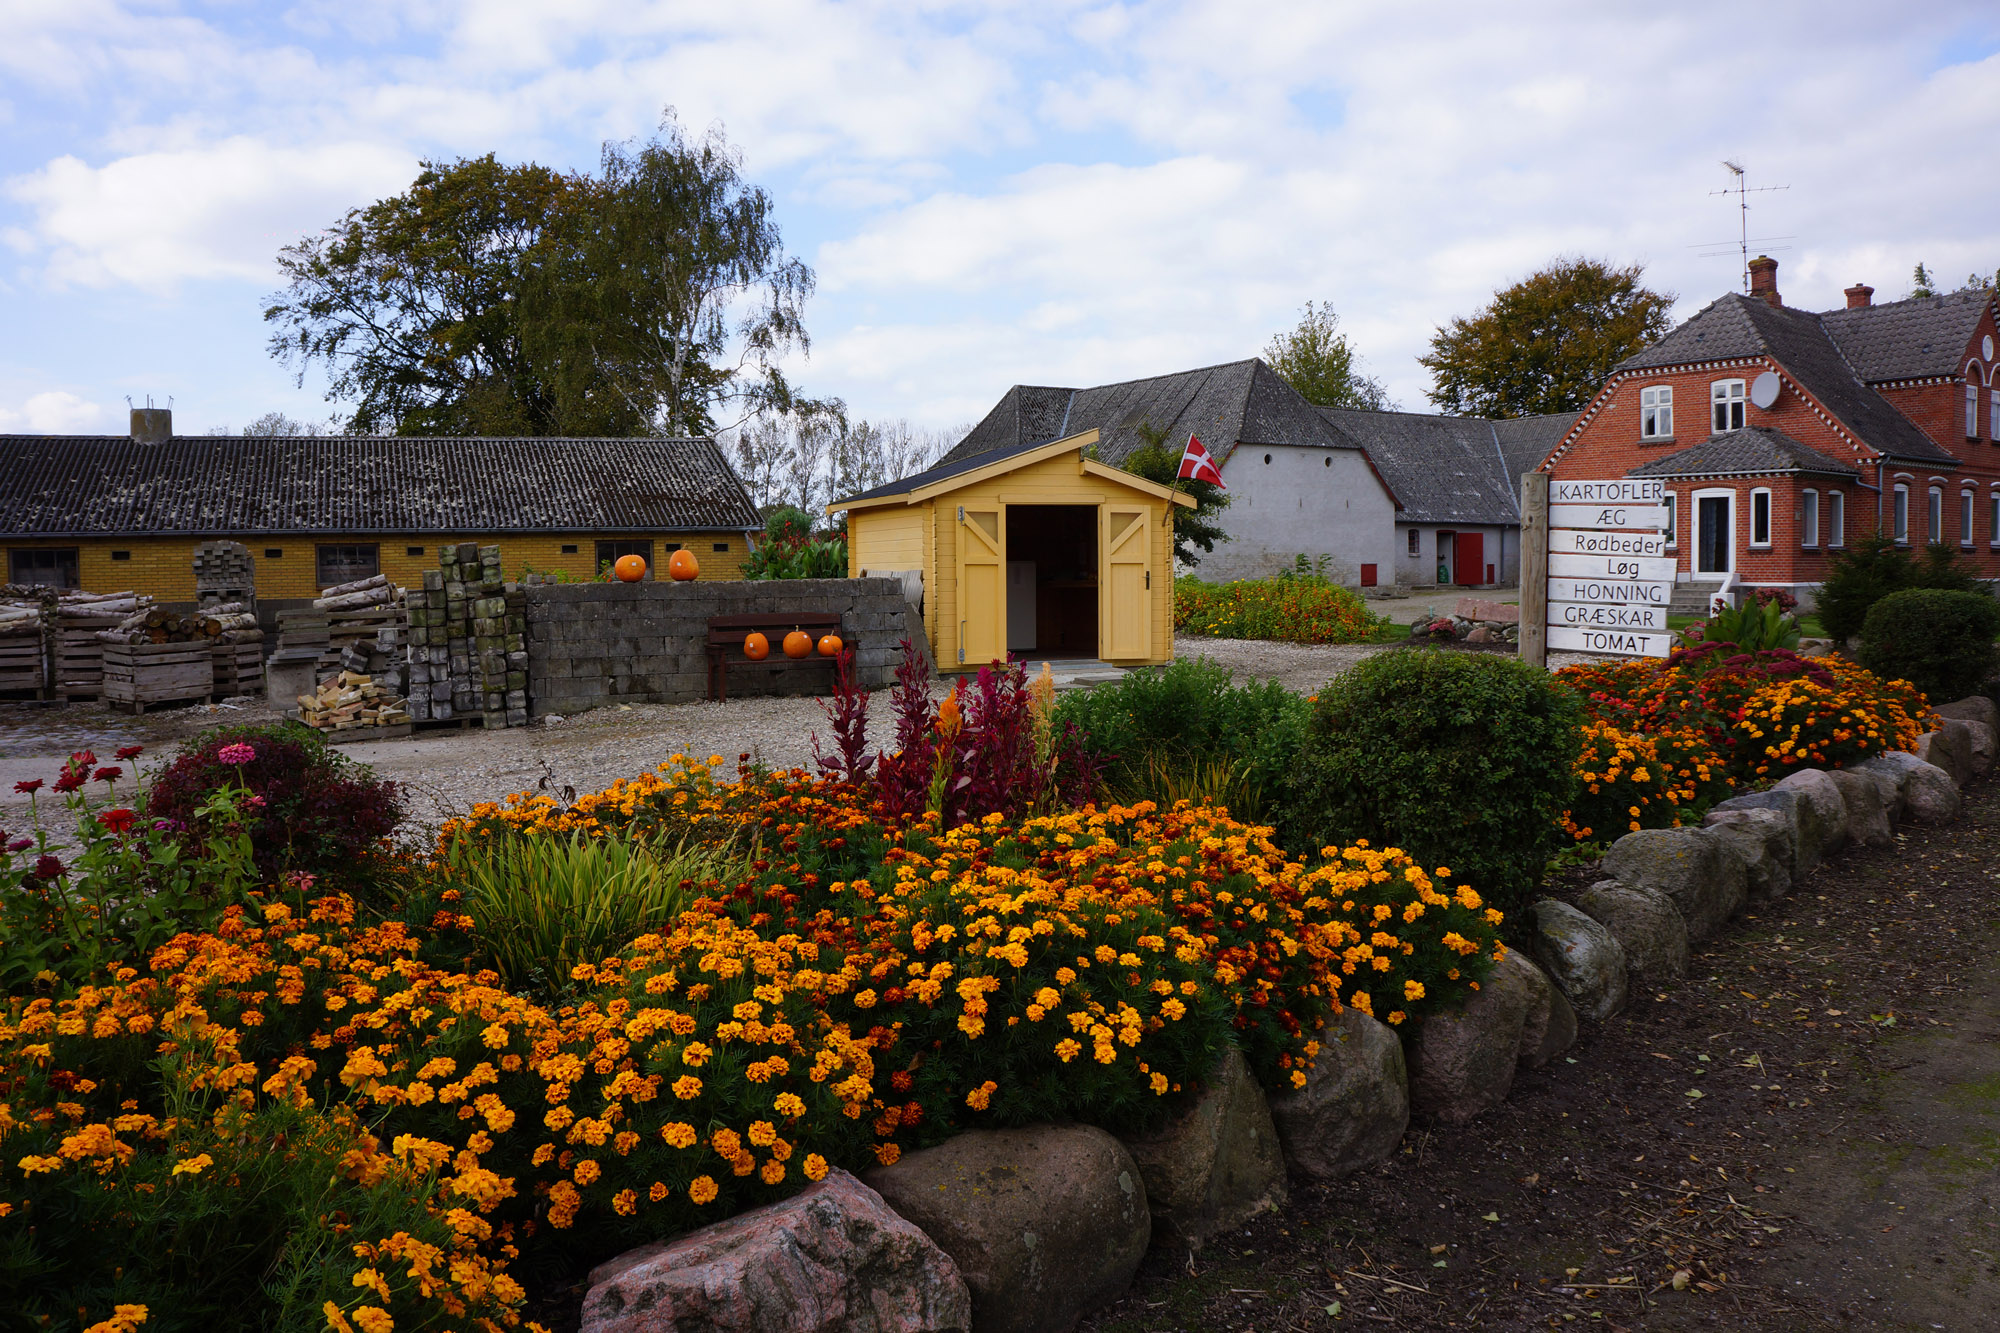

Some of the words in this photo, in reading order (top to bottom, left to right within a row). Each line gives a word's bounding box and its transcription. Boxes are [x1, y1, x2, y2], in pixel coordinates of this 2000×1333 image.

[1559, 483, 1663, 500] KARTOFLER
[1596, 509, 1626, 525] ÆG
[1575, 535, 1663, 553] Rødbeder
[1608, 559, 1639, 579] Løg
[1574, 584, 1662, 602] HONNING
[1565, 607, 1654, 626] GRÆSKAR
[1583, 633, 1650, 652] TOMAT
